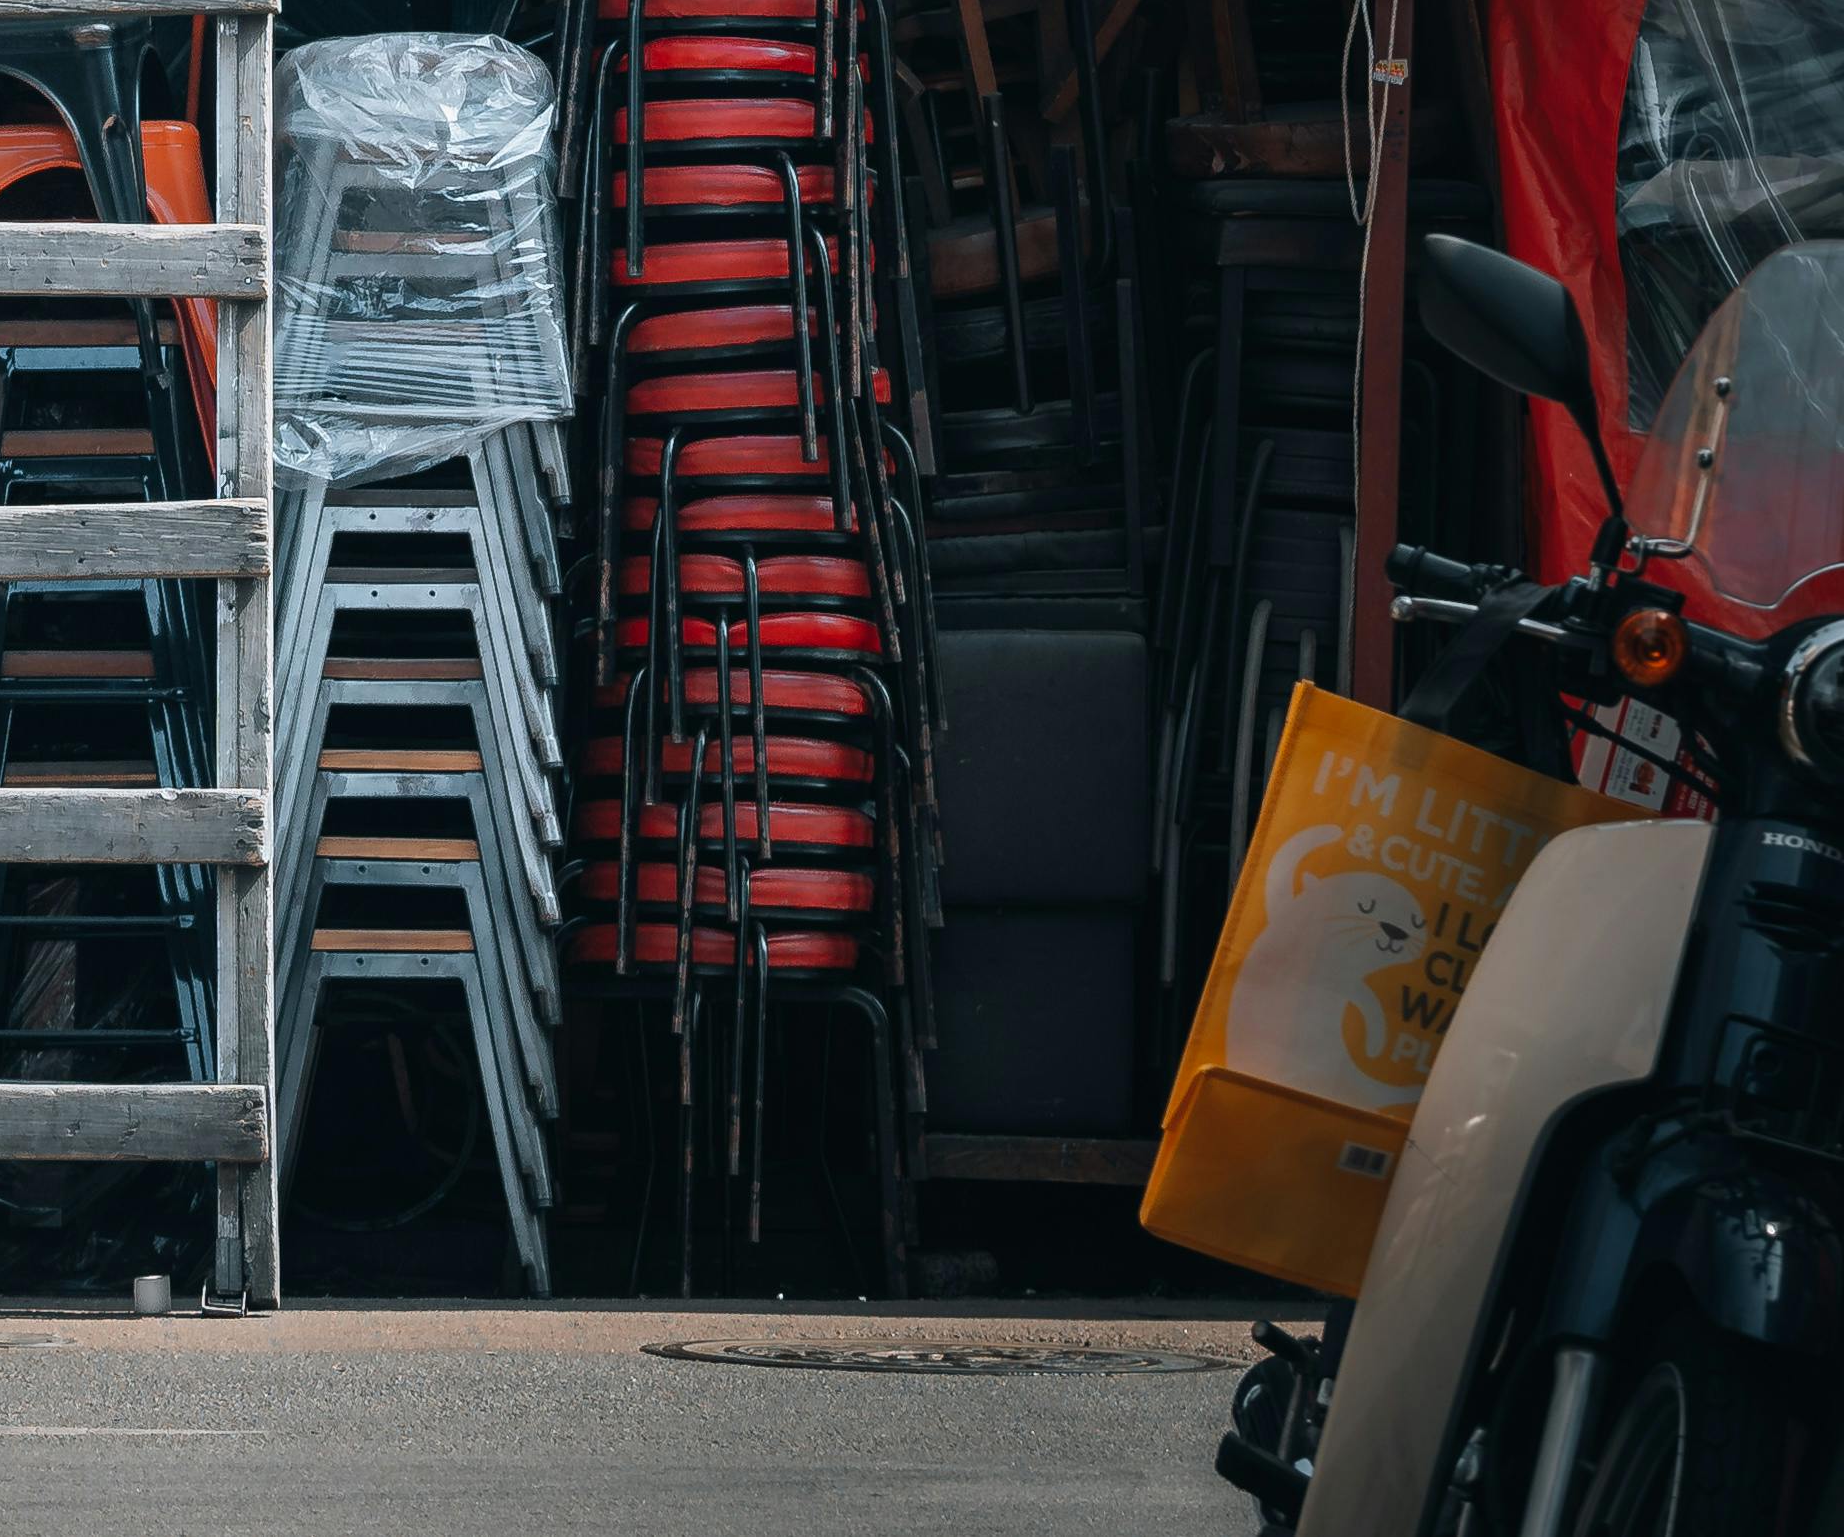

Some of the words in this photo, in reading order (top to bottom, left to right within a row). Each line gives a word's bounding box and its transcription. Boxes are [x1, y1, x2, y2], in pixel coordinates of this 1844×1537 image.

[1313, 750, 1401, 817] I'M
[1762, 831, 1844, 864] HOND
[1433, 902, 1450, 938] I
[1424, 951, 1465, 995] CL
[1390, 1033, 1431, 1074] PL
